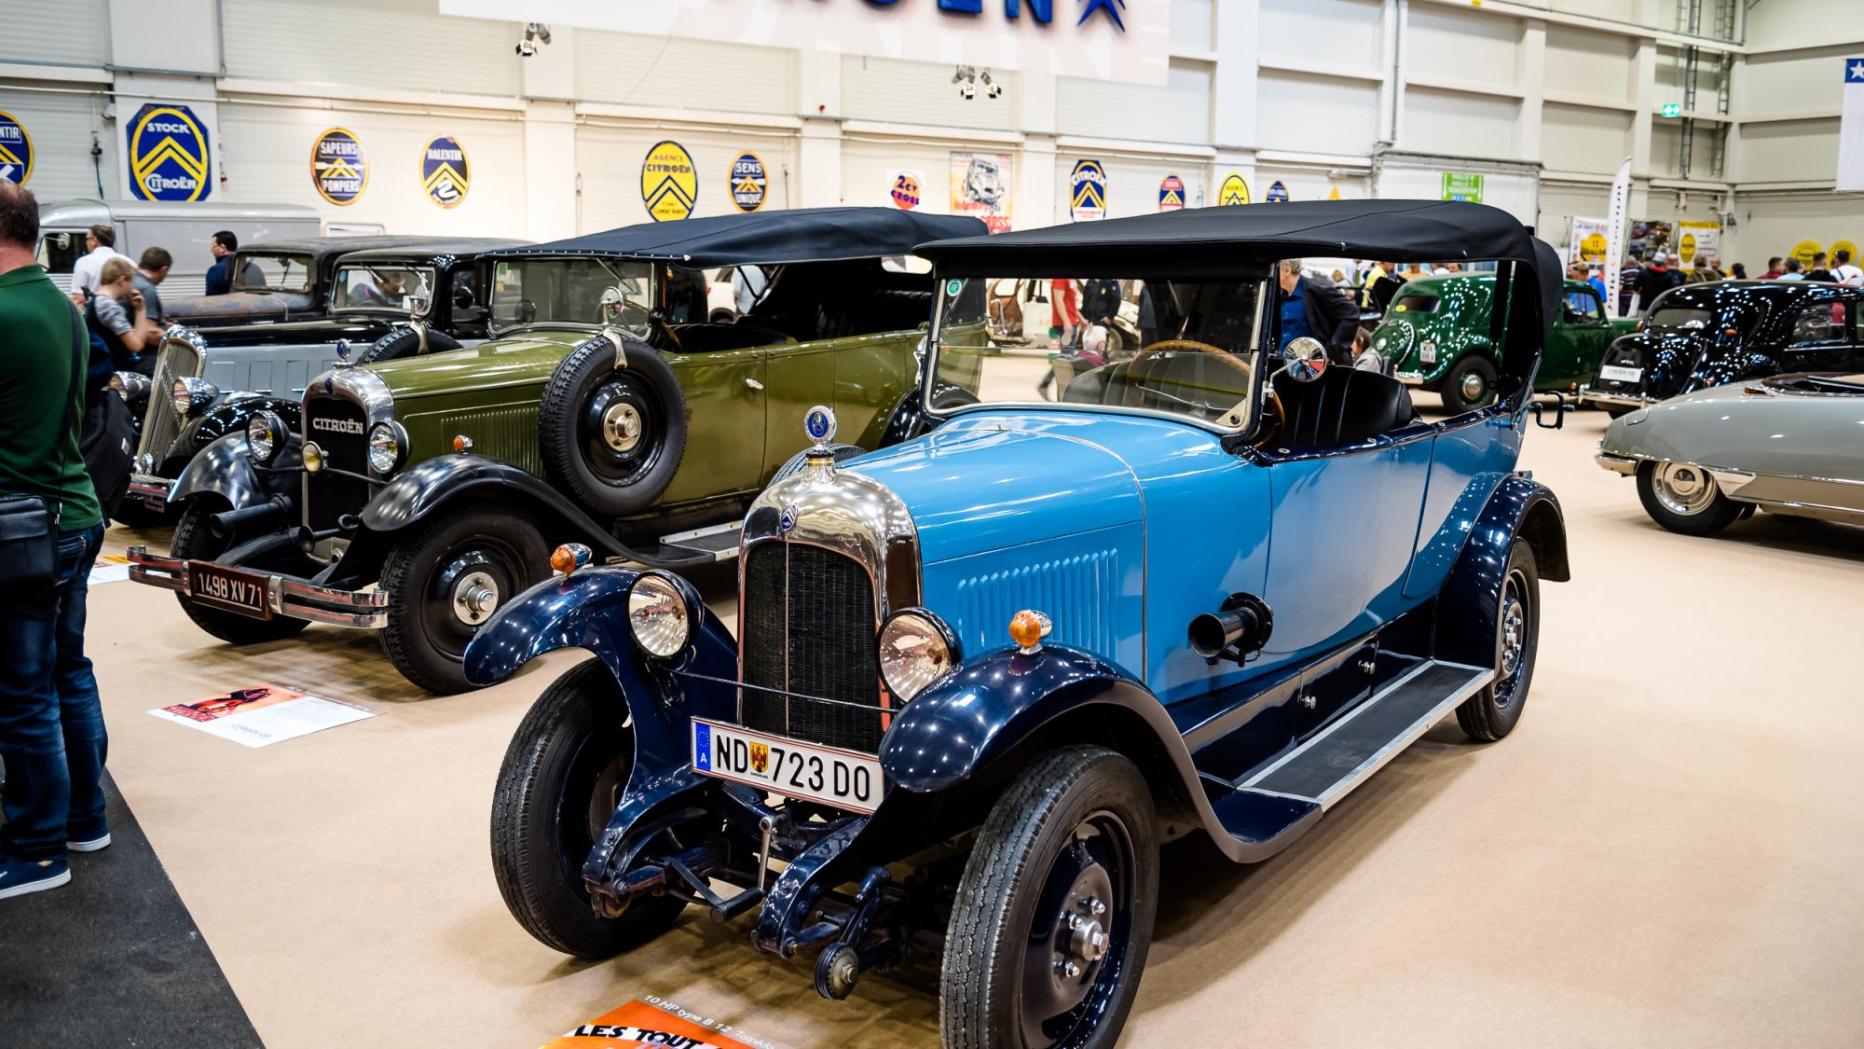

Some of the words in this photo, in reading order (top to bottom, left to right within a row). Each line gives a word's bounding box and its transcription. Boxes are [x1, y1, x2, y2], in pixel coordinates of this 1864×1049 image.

[147, 122, 190, 134] STOCK
[320, 141, 358, 155] SAPEURS
[735, 162, 762, 174] SENS
[322, 180, 359, 193] POMPIERS
[199, 572, 229, 599] 1498
[230, 579, 246, 603] XV
[248, 583, 262, 607] 71
[700, 752, 708, 764] A
[716, 734, 749, 774] ND
[770, 746, 824, 792] 723
[644, 994, 660, 1004] 10
[658, 1000, 680, 1010] HP
[677, 1008, 703, 1023] type
[702, 1017, 715, 1026] B
[715, 1023, 732, 1034] 12
[574, 1025, 625, 1038] LES
[635, 1028, 705, 1049] TOUT
